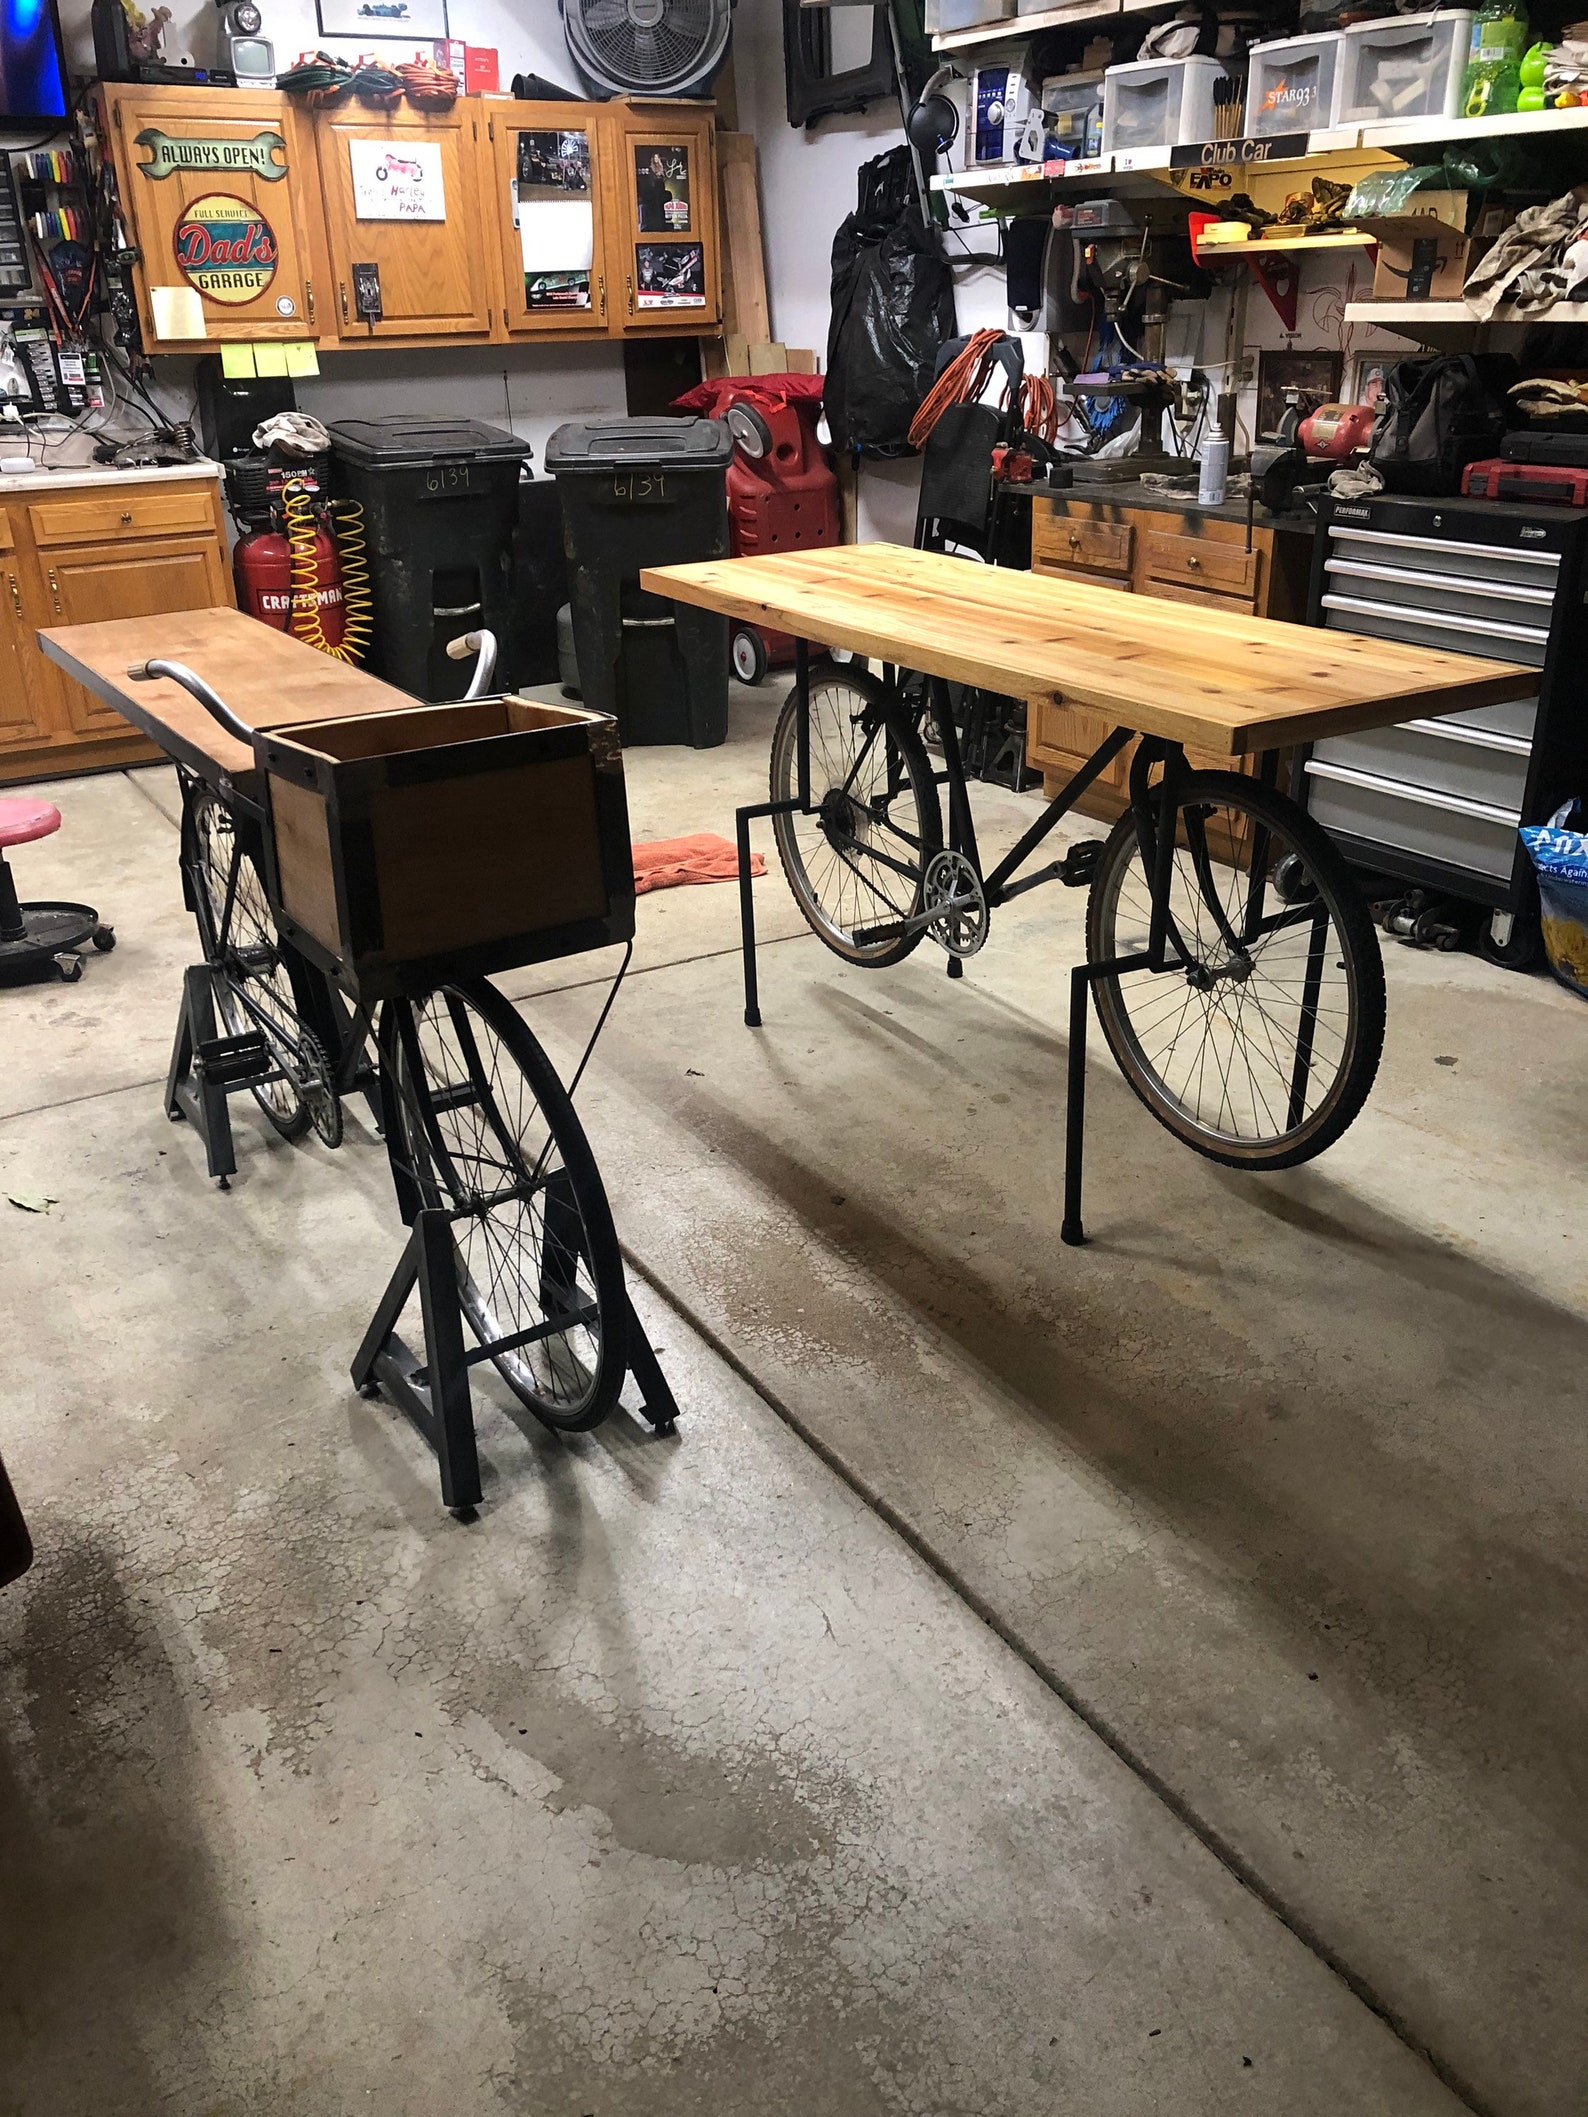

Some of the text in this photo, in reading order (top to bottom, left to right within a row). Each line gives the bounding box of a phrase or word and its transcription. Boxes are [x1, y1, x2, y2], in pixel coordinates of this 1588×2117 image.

[162, 145, 266, 165] ALWAYS OPEN!
[1201, 140, 1272, 165] Club Car
[194, 209, 213, 219] FULL
[399, 202, 426, 214] PAPA
[177, 223, 278, 266] Dad's
[198, 272, 265, 290] GARAGE
[426, 466, 470, 492] 6139
[613, 472, 666, 500] 6139
[262, 587, 343, 610] CRAFTSMAN
[1560, 865, 1588, 878] Again
